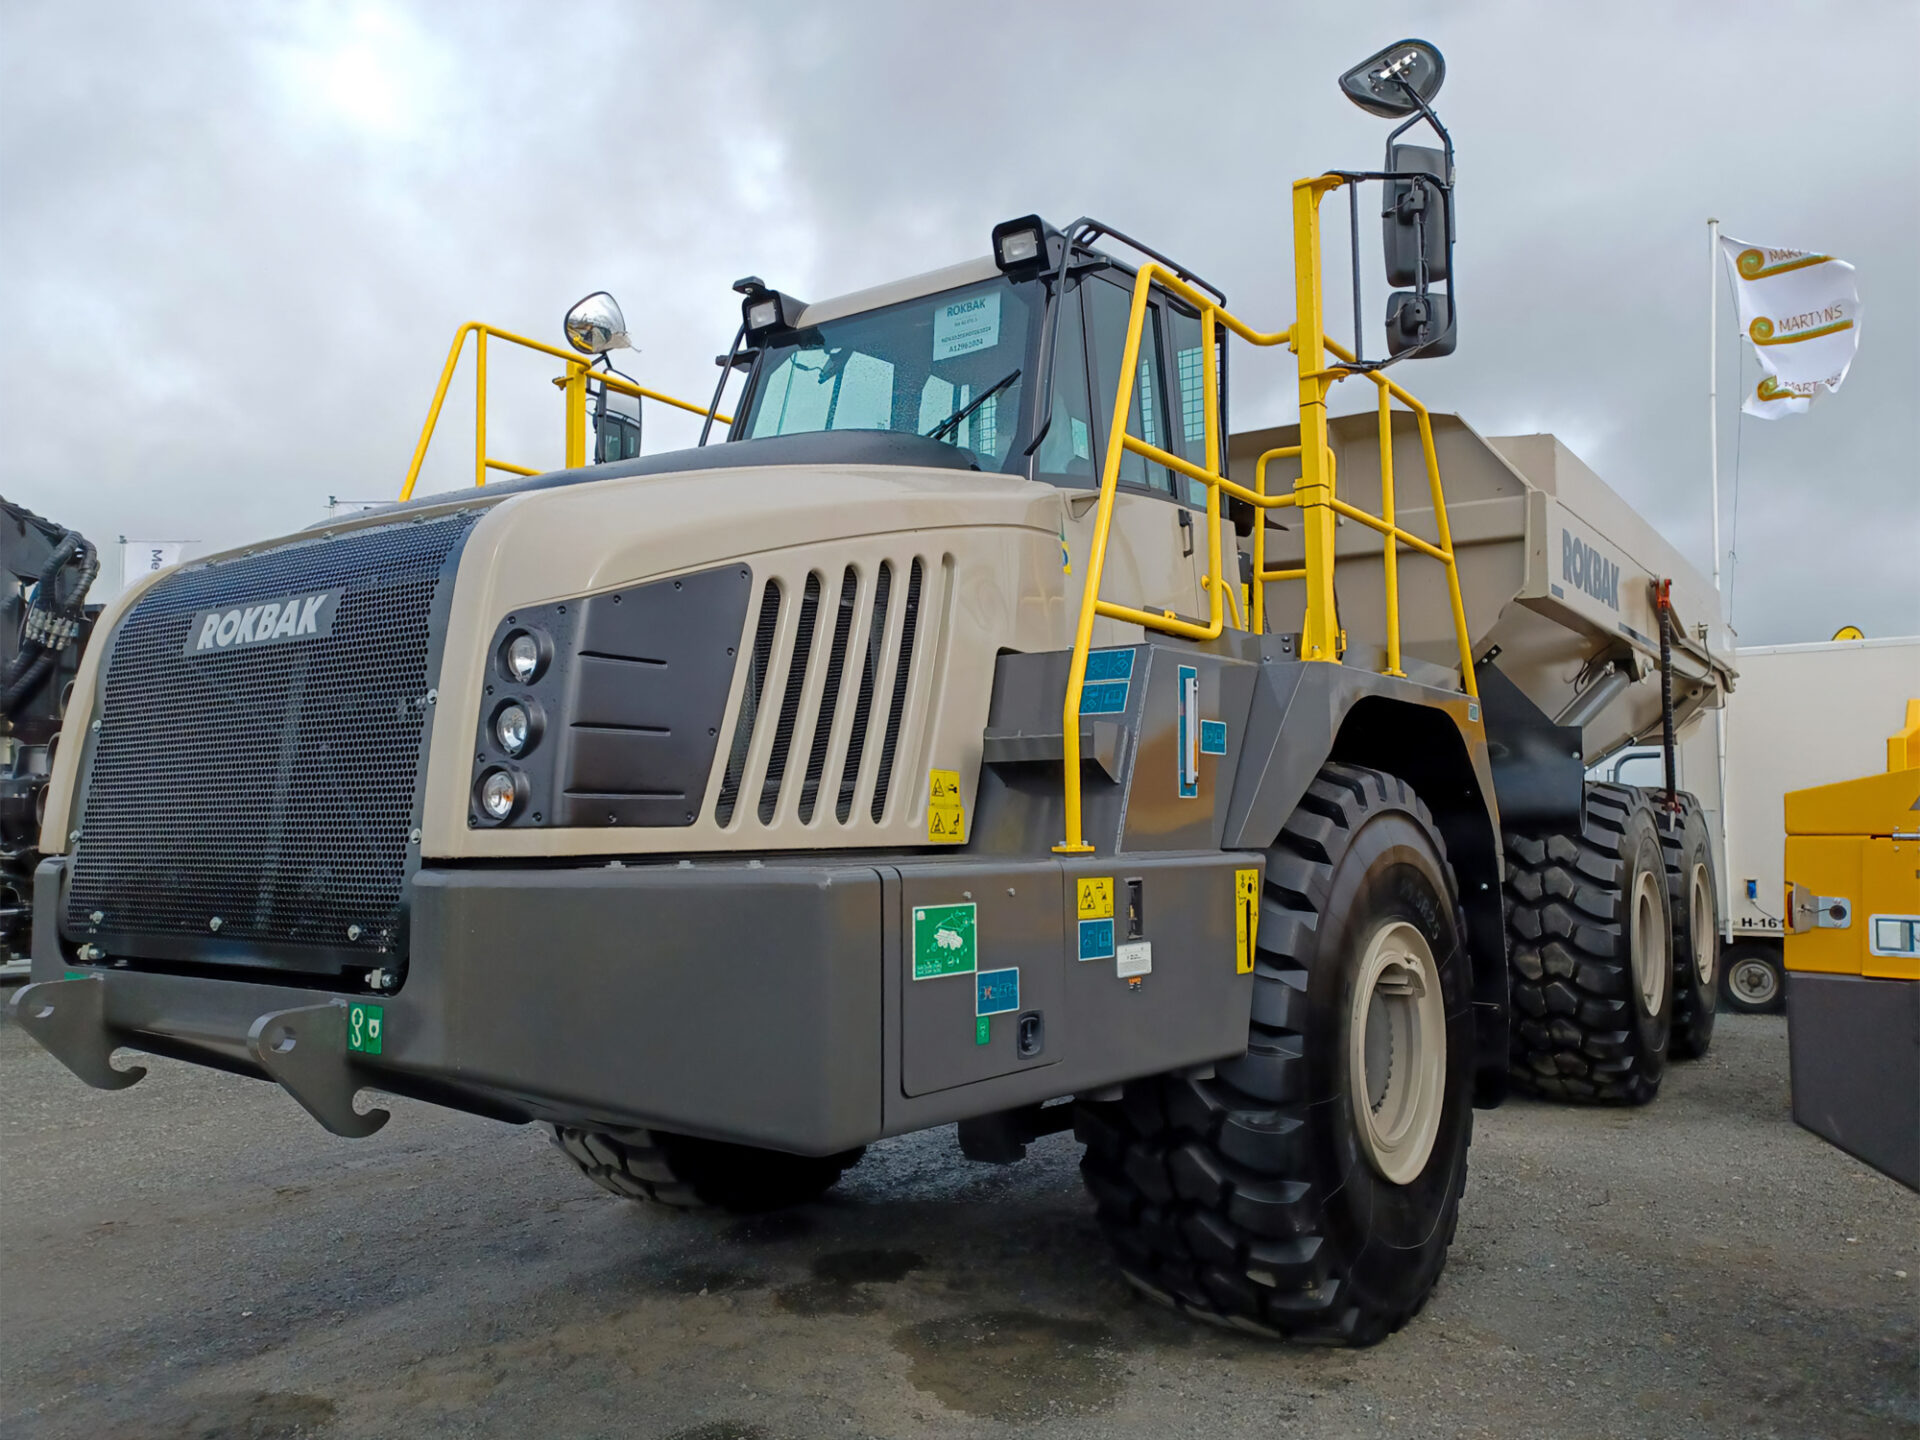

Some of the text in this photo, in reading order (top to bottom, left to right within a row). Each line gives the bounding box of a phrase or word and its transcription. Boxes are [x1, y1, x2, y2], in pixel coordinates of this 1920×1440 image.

[946, 298, 986, 317] ROKBAK
[1779, 304, 1843, 333] MARTYNS
[1562, 528, 1620, 612] ROKBAK
[196, 594, 329, 650] ROKBAK
